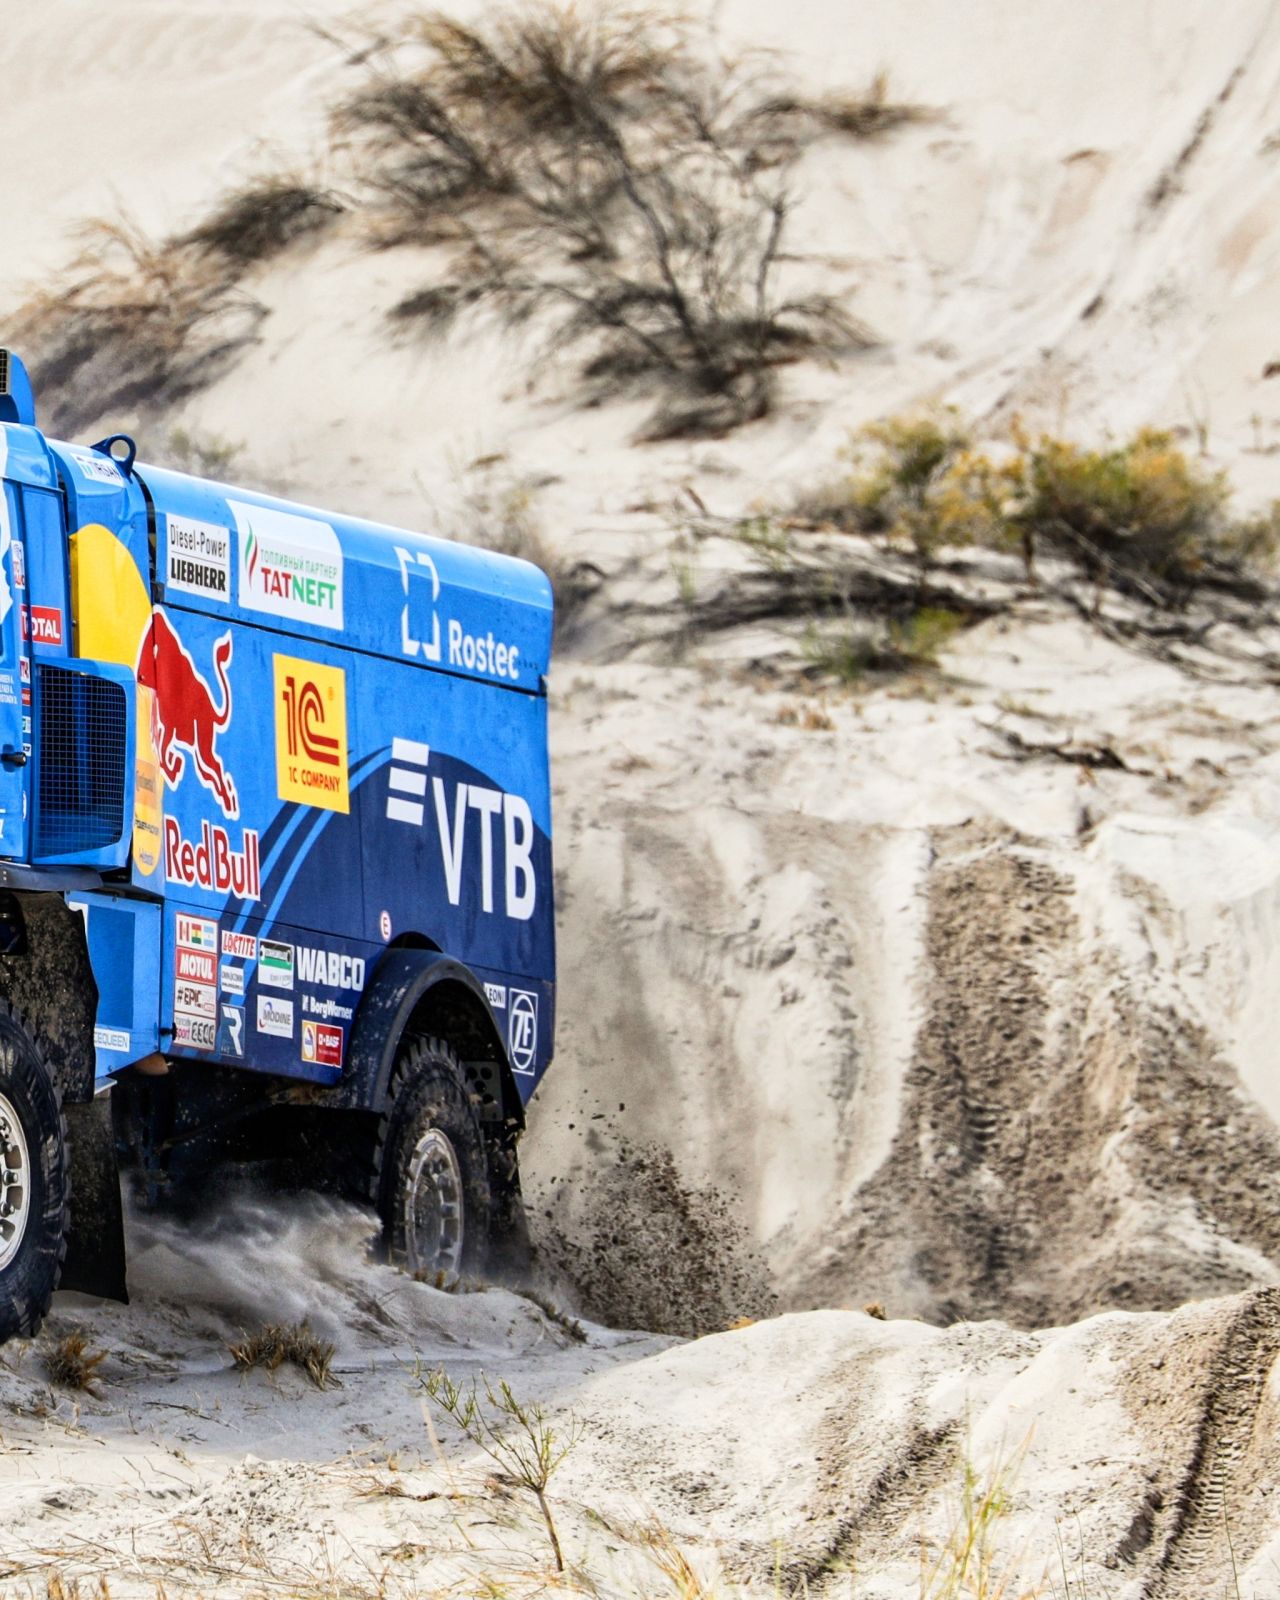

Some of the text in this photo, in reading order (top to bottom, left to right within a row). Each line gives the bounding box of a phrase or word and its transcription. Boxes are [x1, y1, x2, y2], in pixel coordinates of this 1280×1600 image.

[170, 524, 227, 559] Diesel-Power
[170, 557, 227, 593] LIEBHERR
[260, 548, 338, 579] ТОПЛИВНЫЙ ПАРТНЕР
[260, 567, 337, 610] TATNEFT
[21, 610, 61, 639] TOTAL
[447, 619, 520, 681] Rostec
[301, 769, 340, 793] COMPANY
[165, 817, 260, 898] Red Bull
[431, 775, 536, 921] VTB
[223, 933, 256, 958] LOCTITE
[179, 952, 214, 980] MOTUL
[296, 945, 366, 992] WABCO
[263, 1009, 291, 1025] MODINE
[310, 996, 354, 1020] BorgWarner
[512, 1008, 535, 1056] ZF
